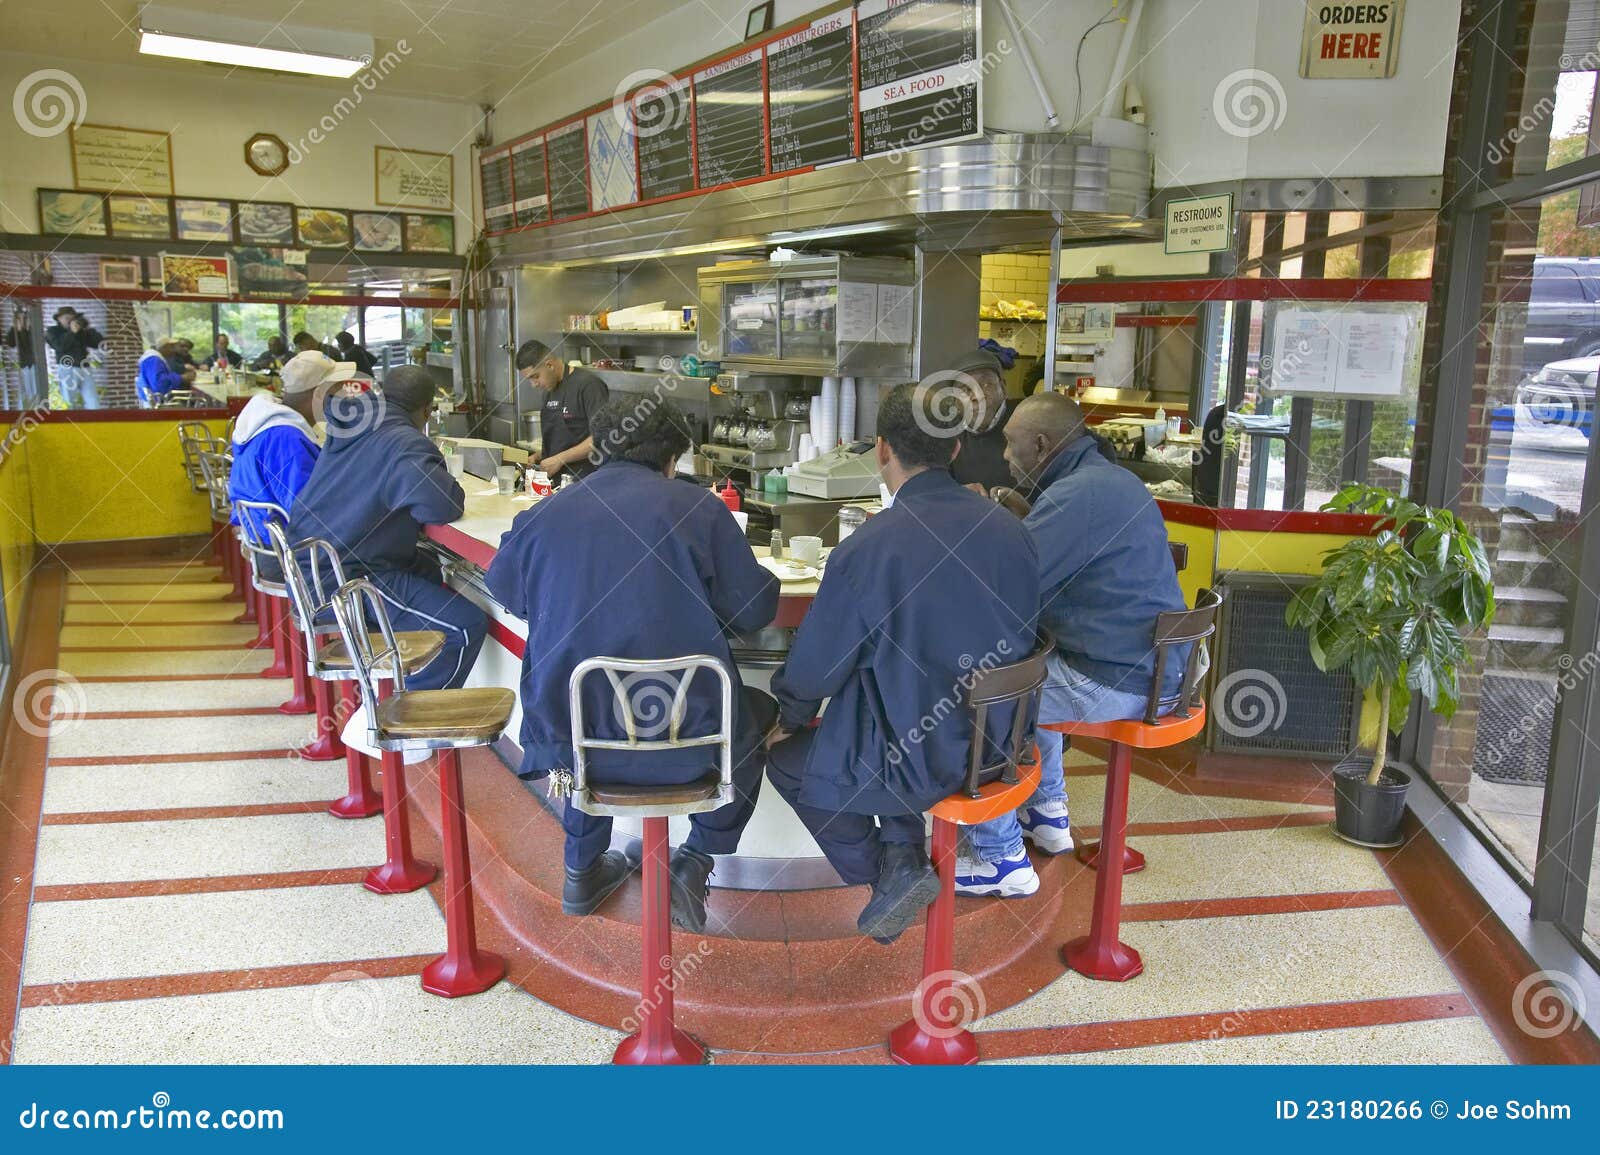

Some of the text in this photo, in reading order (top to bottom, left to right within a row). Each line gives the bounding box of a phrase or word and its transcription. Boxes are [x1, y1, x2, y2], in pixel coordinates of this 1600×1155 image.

[1319, 5, 1389, 24] ORDERS
[778, 17, 842, 51] HAMBURGERS
[1320, 32, 1383, 59] HERE
[704, 53, 753, 79] SANDWICHES
[883, 86, 906, 100] SEA
[910, 74, 945, 94] FOOD
[1173, 206, 1223, 223] RESTROOMS
[342, 381, 362, 393] NO
